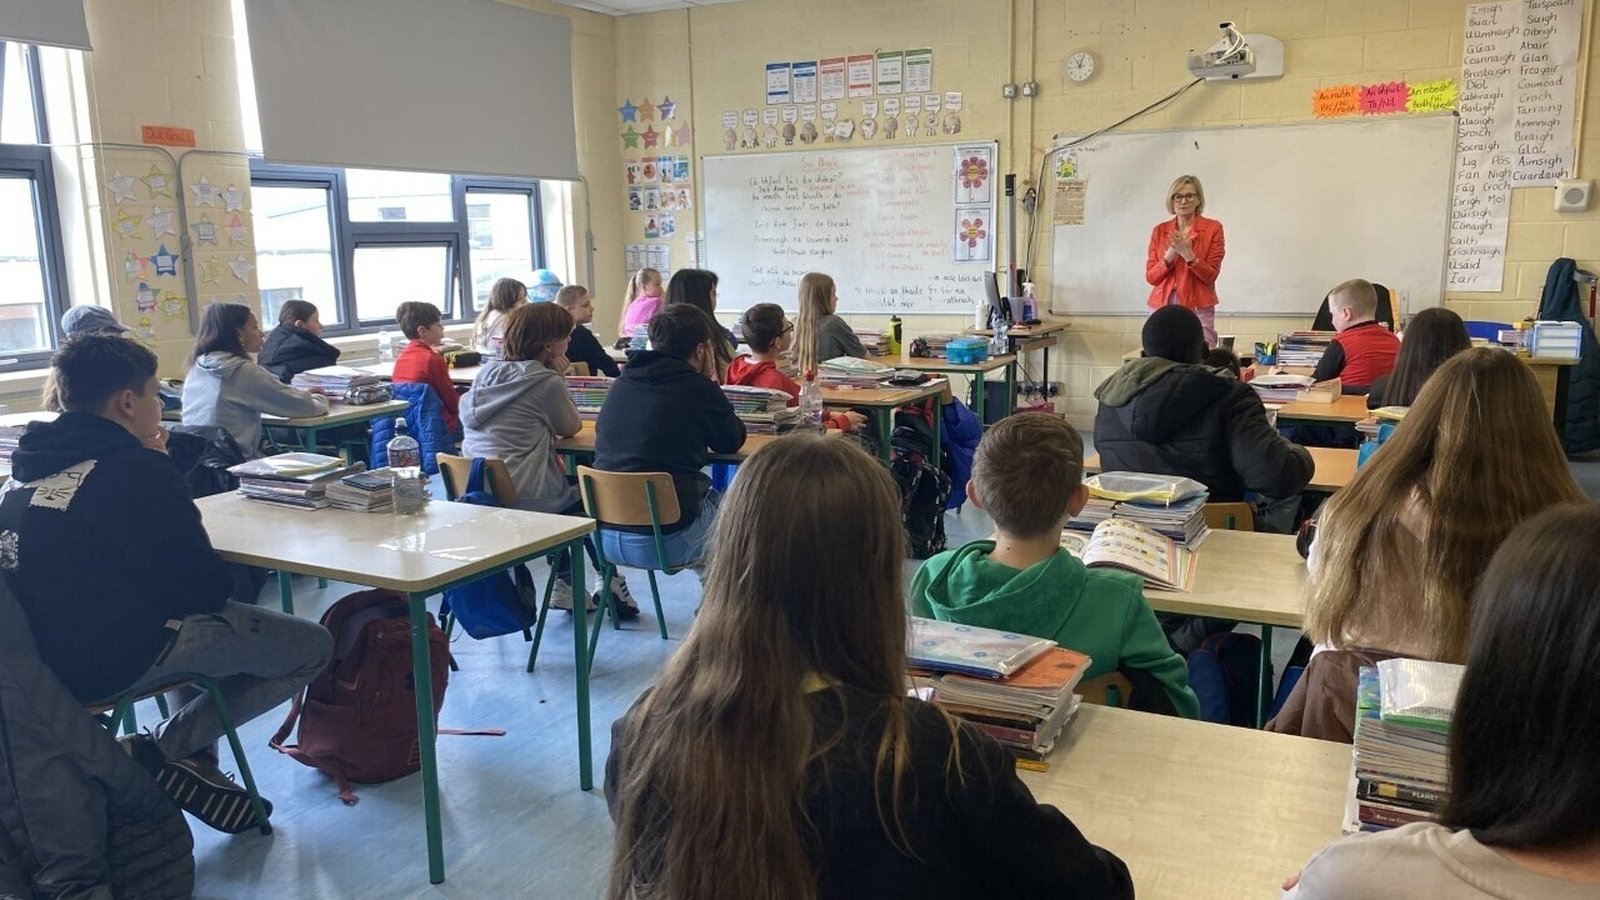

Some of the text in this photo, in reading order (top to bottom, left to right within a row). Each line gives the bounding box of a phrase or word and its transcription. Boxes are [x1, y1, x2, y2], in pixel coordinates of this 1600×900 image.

[1469, 18, 1498, 26] Buail
[1527, 12, 1557, 25] Suigh
[1520, 41, 1549, 51] Abair
[1522, 53, 1549, 63] Glan
[1366, 89, 1376, 97] An
[1520, 91, 1552, 103] Croch
[1461, 103, 1495, 115] Bailigh
[1518, 154, 1562, 169] Aimsigh
[1458, 168, 1512, 182] Fan Nigh
[1513, 168, 1569, 180] Cuardaigh
